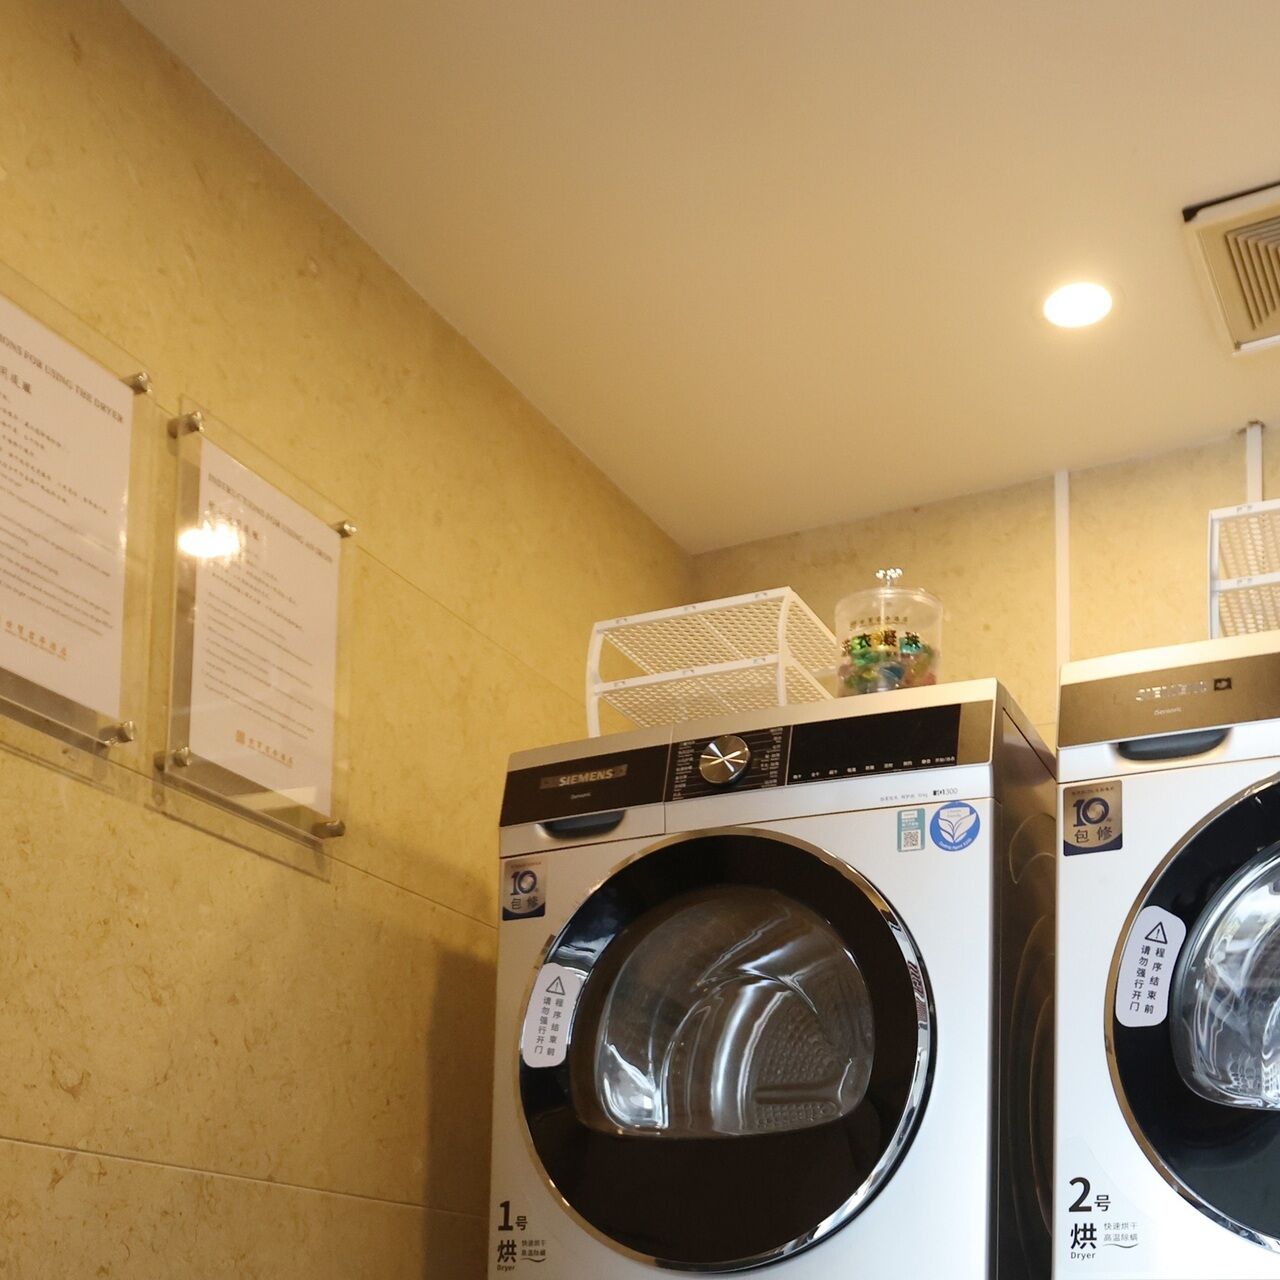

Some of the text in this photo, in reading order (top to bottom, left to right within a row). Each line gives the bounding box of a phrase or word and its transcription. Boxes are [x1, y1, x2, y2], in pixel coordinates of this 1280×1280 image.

[23, 351, 43, 370] FOR
[558, 768, 614, 788] SIEMENS
[1129, 944, 1151, 1012] 请勿强行开门
[1144, 947, 1166, 1014] 程序结束前
[1069, 1177, 1111, 1212] 2号
[498, 1200, 528, 1231] 1号
[1104, 1221, 1137, 1230] 快速烘干
[1070, 1223, 1097, 1249] 烘
[497, 1239, 517, 1263] 烘
[1070, 1251, 1096, 1261] Dryer
[497, 1264, 515, 1272] Dryer
